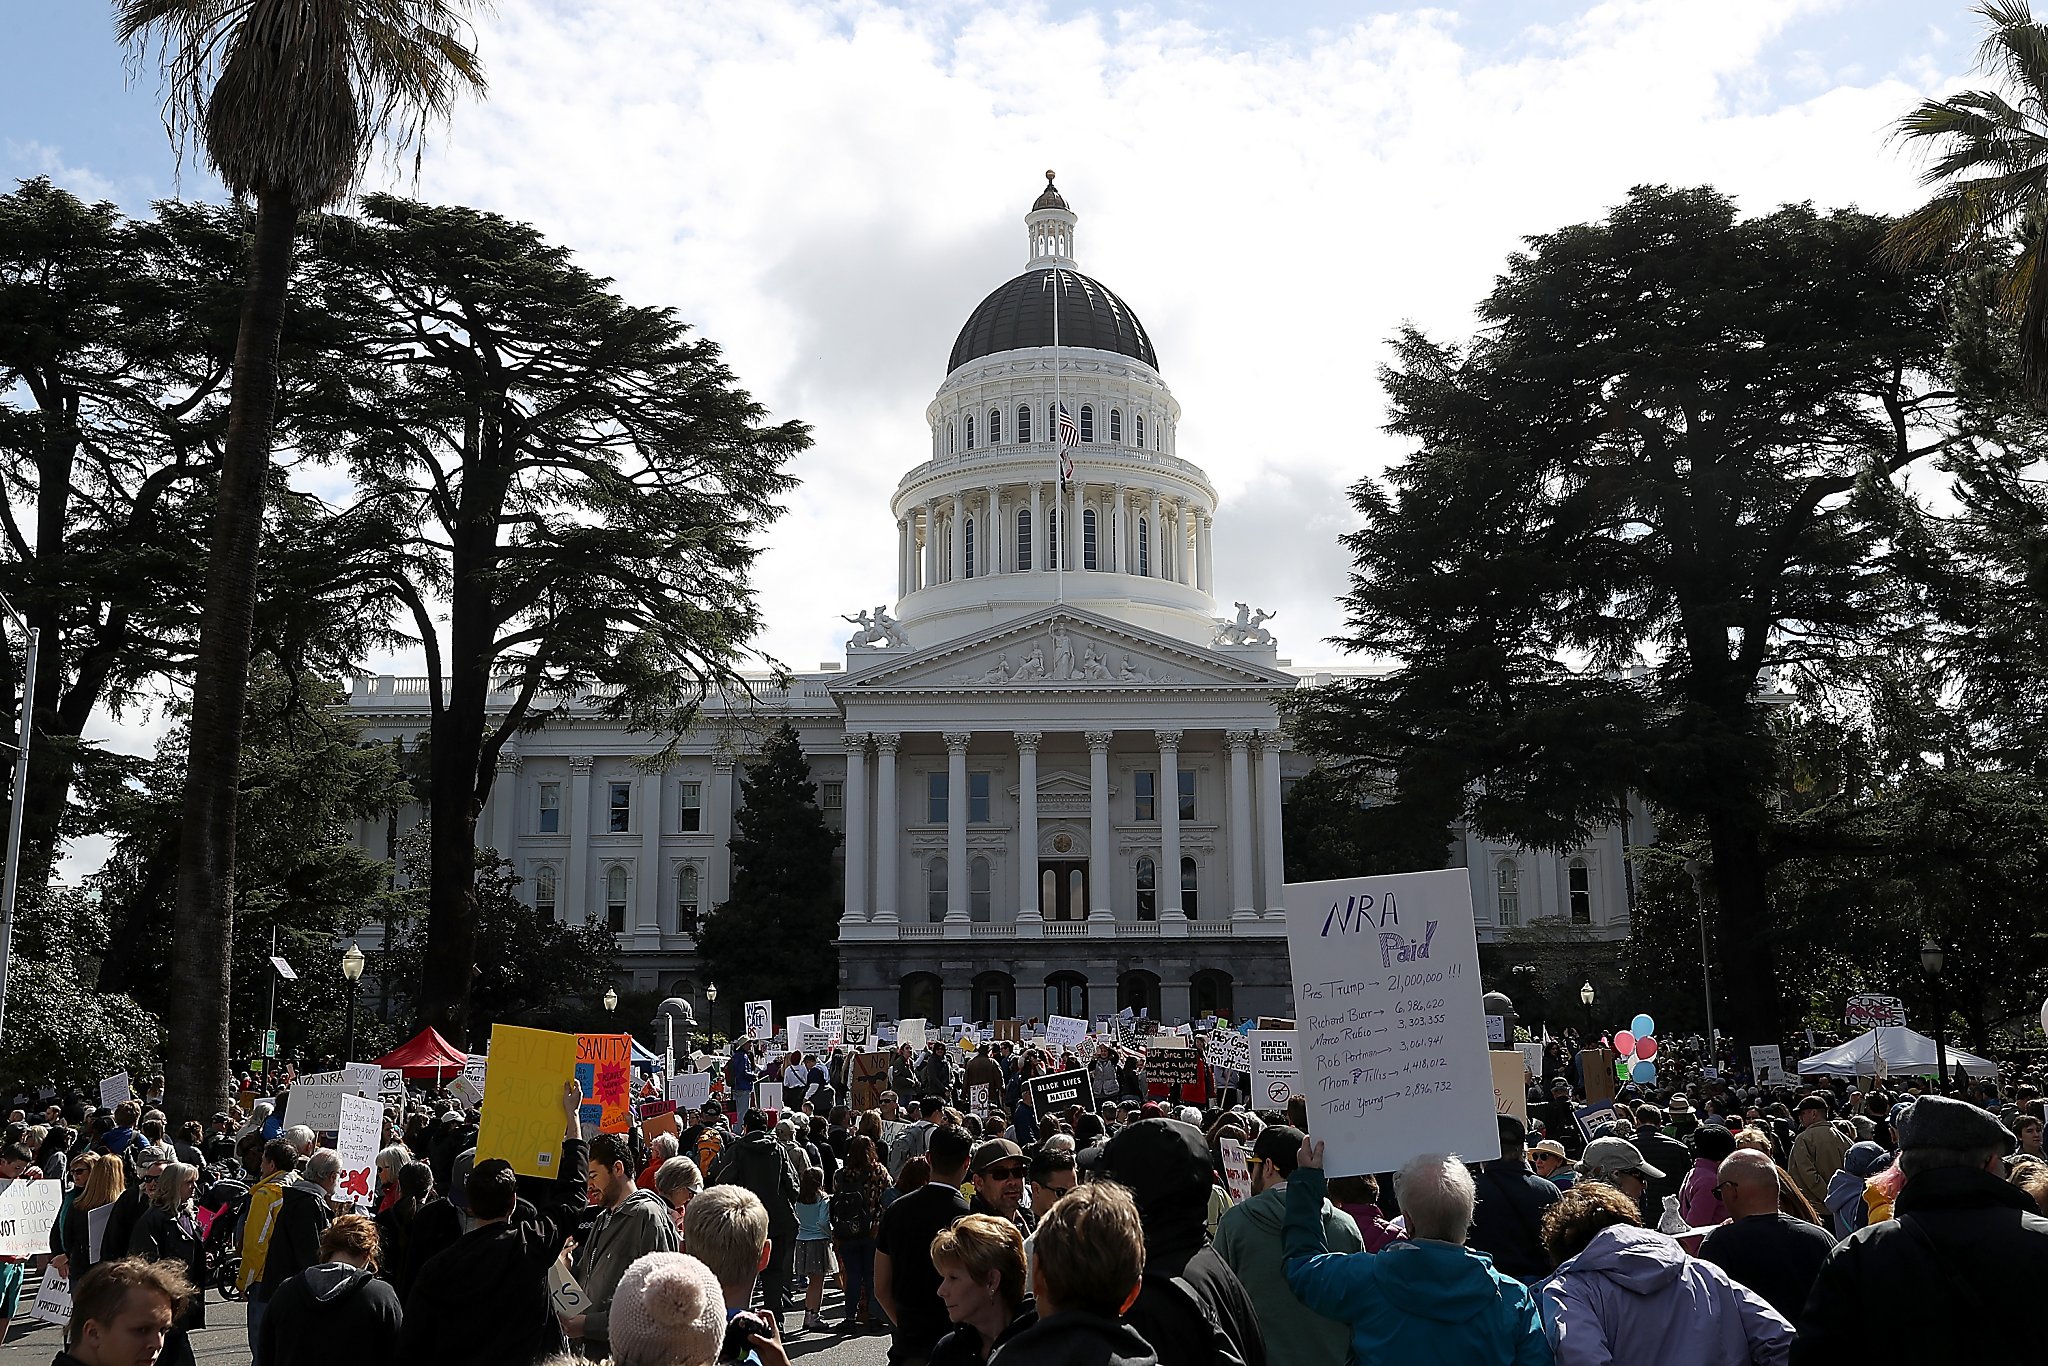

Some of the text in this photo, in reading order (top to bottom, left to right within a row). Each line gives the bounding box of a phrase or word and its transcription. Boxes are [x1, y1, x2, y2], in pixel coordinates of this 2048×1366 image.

[1320, 892, 1399, 937] NRA
[1379, 920, 1438, 968] Paid
[1302, 983, 1325, 1000] Pres.
[1320, 980, 1365, 998] Trump
[1387, 972, 1443, 993] 21,000,000
[1307, 1014, 1345, 1031] Richard
[1348, 1007, 1373, 1022] Burr
[1213, 1030, 1231, 1045] Hey
[1309, 1033, 1340, 1050] Marco
[1340, 1026, 1372, 1042] Rubio
[576, 1036, 630, 1061] SANITY
[1210, 1043, 1225, 1055] See
[1316, 1054, 1341, 1071] Rob
[1345, 1049, 1378, 1064] Portman
[320, 1072, 345, 1085] NRA
[1037, 1077, 1081, 1092] BLACK LIVES
[1318, 1075, 1350, 1092] Thom
[1362, 1068, 1387, 1083] Tillis
[670, 1083, 706, 1099] ENOUGH
[1050, 1090, 1075, 1101] MATTER
[313, 1101, 334, 1109] NOT
[1321, 1098, 1351, 1115] Todd
[1354, 1096, 1385, 1118] Young
[36, 1183, 49, 1196] TO
[22, 1200, 56, 1216] BOOKS
